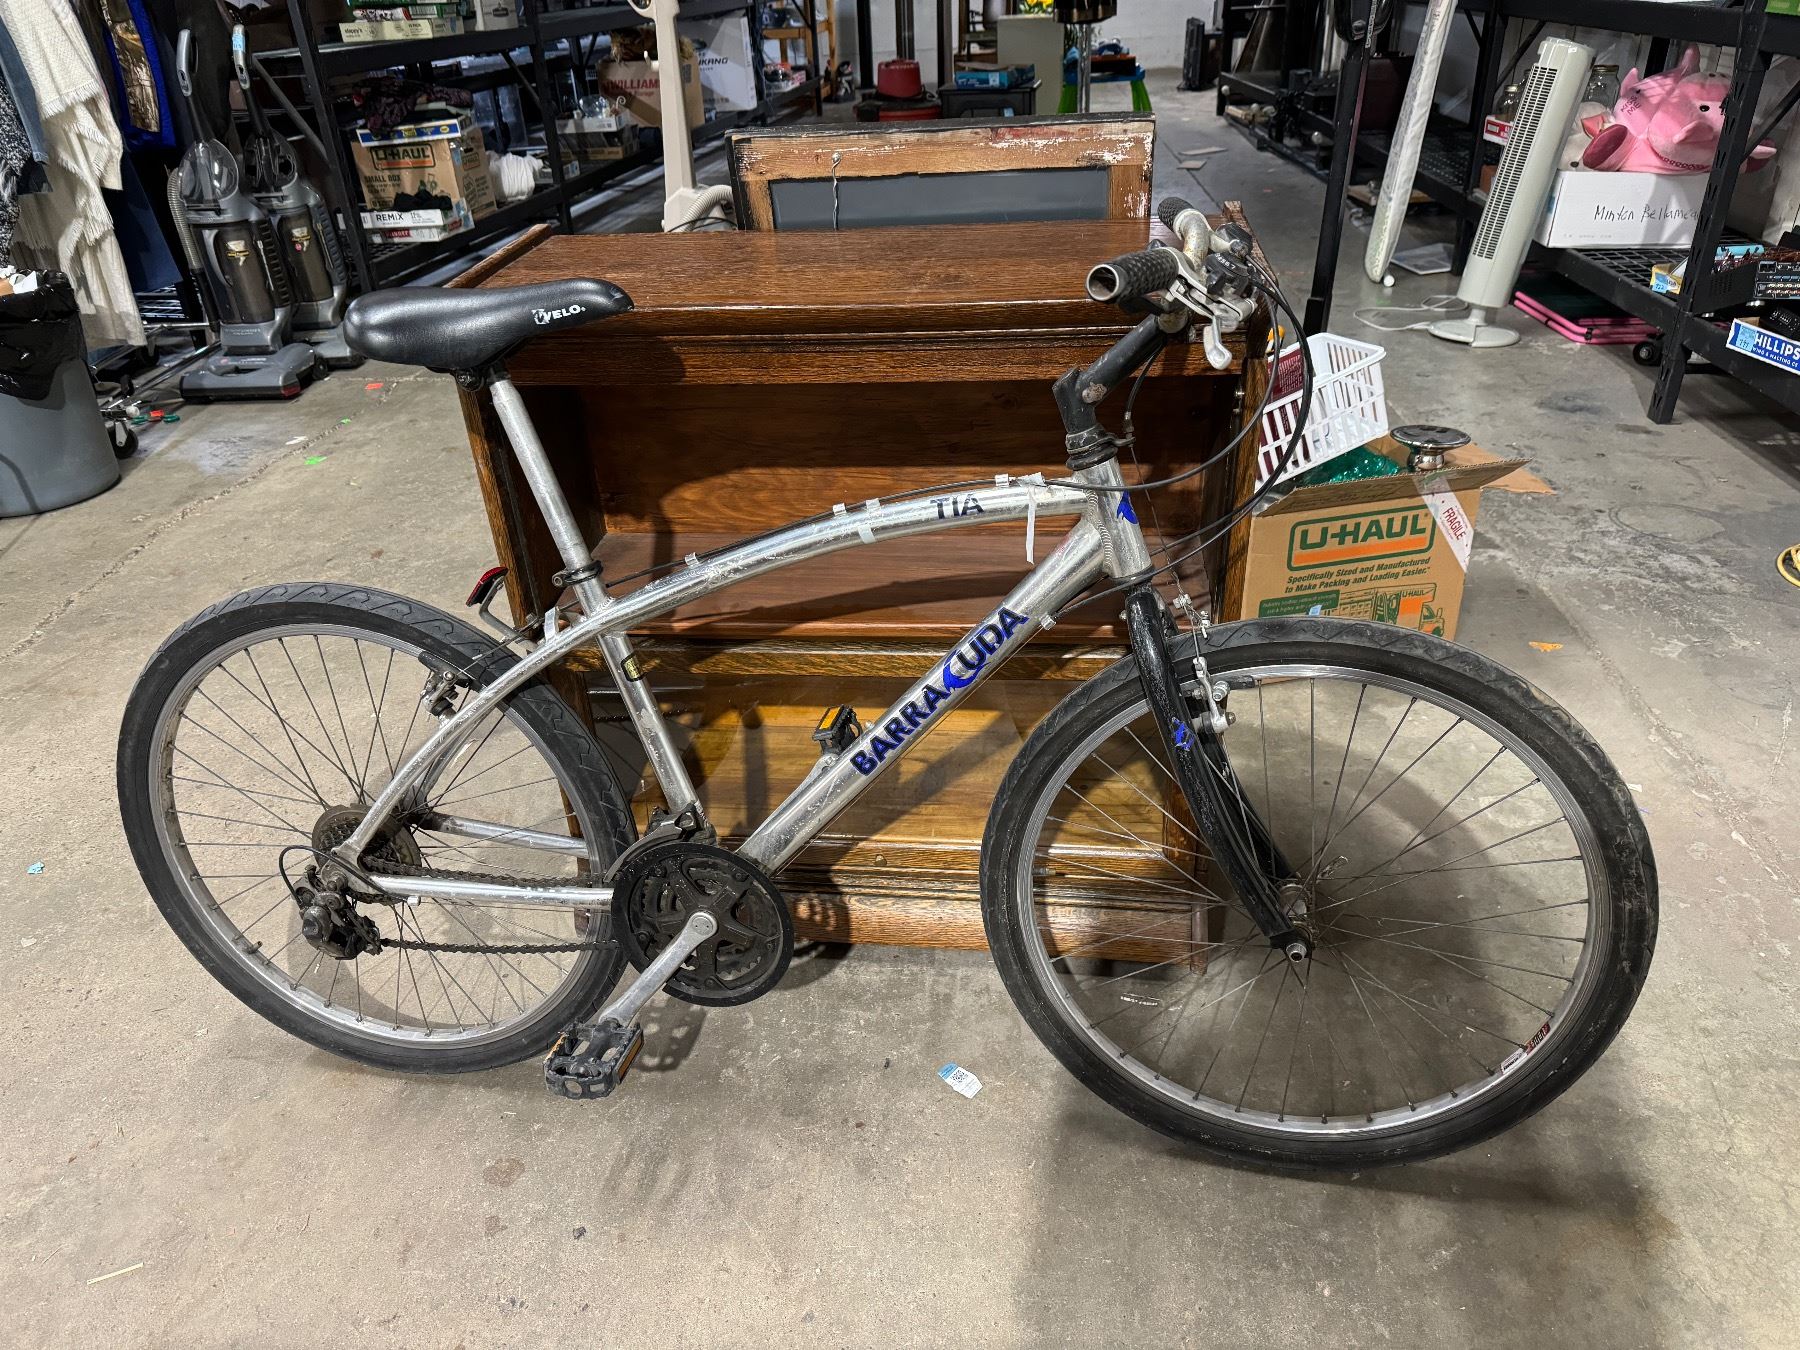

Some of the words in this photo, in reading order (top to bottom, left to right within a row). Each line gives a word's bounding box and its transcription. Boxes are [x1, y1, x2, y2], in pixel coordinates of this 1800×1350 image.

[1755, 331, 1800, 361] HILLIPS
[930, 494, 984, 519] TIA
[1299, 513, 1427, 551] U-HAUL
[1442, 507, 1467, 541] FRAGILE
[1287, 571, 1334, 585] Specifically
[1336, 567, 1358, 576] Sized
[1359, 566, 1374, 574] and
[1376, 557, 1431, 572] Manufactured
[1295, 584, 1317, 593] Make
[1319, 578, 1350, 589] Packing
[1352, 575, 1367, 584] and
[1369, 571, 1399, 582] Loading
[1402, 589, 1425, 598] U-HAUL
[849, 606, 1029, 776] BARRACUDA
